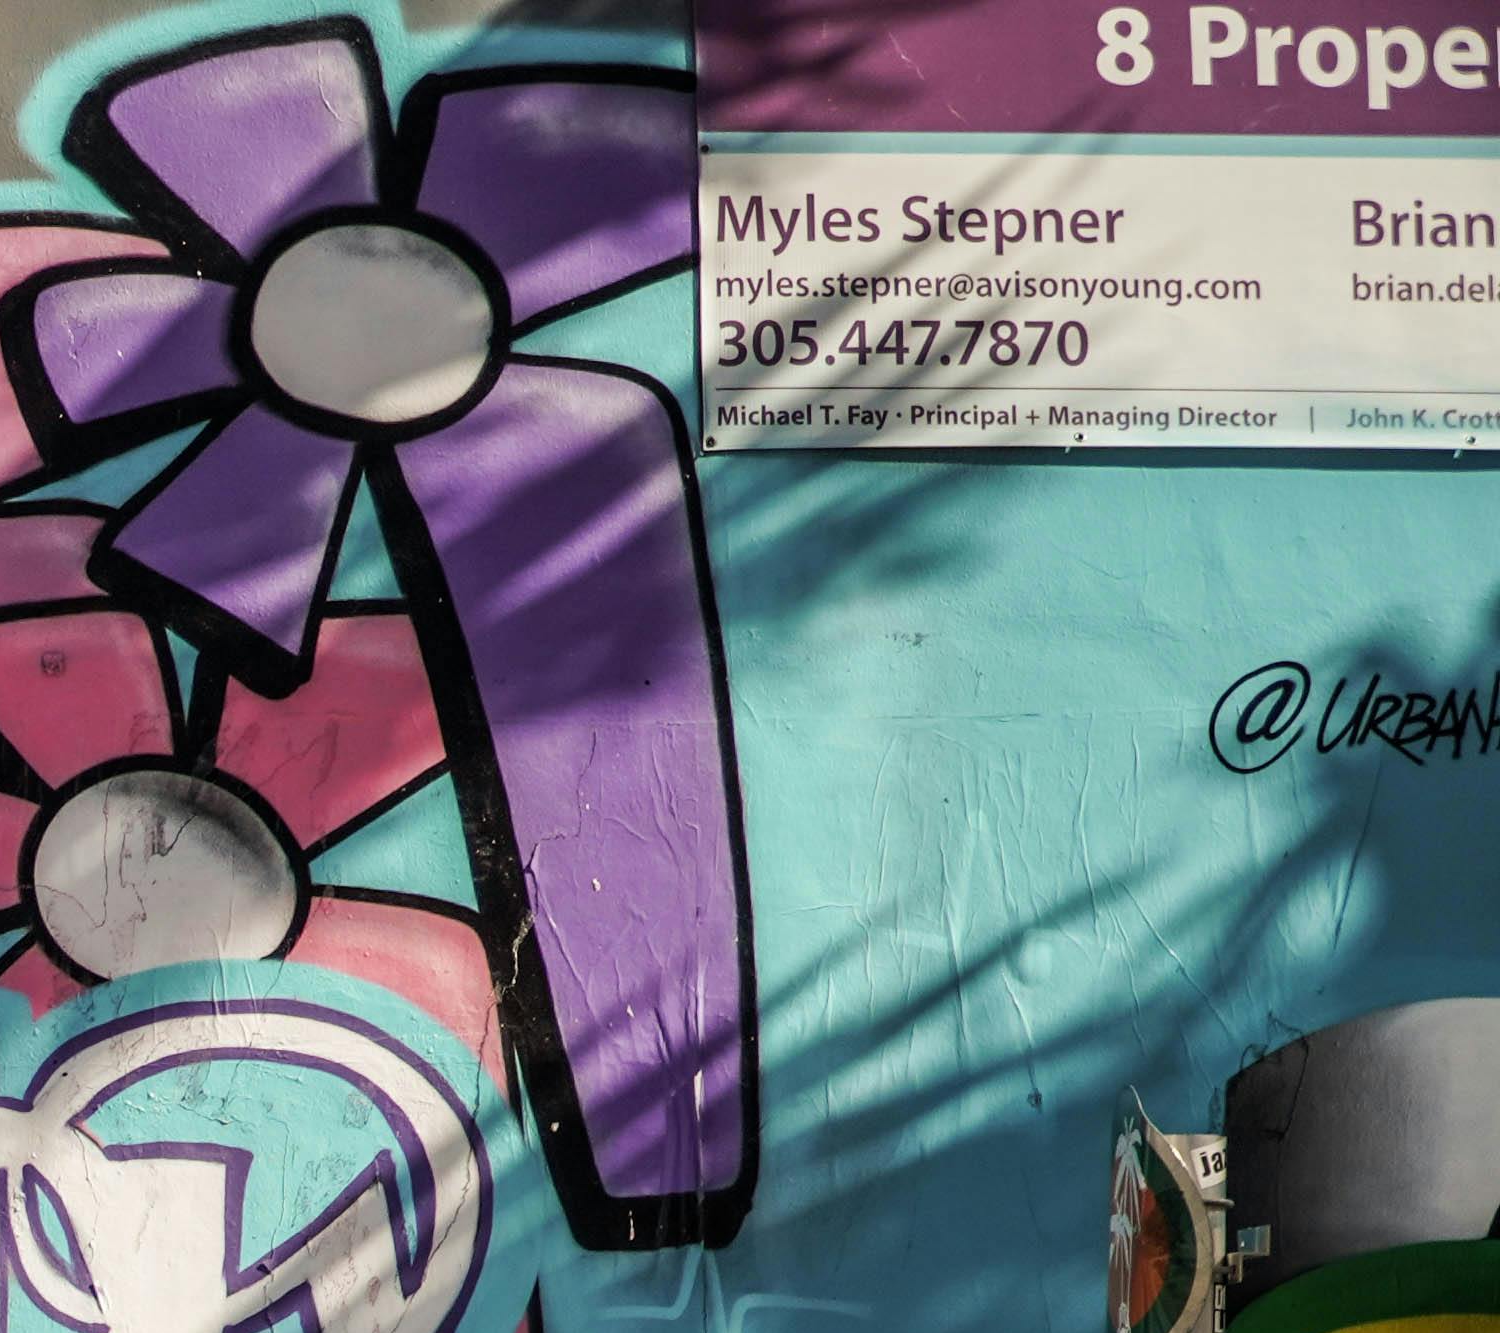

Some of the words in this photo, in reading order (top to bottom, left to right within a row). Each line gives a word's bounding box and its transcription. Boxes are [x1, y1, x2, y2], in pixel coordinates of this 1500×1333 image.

[1096, 7, 1155, 87] 8
[1190, 7, 1500, 110] Prope
[716, 194, 880, 255] Myles
[902, 195, 1125, 256] Stepner
[1352, 199, 1496, 248] Brian
[716, 269, 1262, 306] myles.stepner@avisonyoung.com
[717, 320, 1089, 366] 305.447.7870
[717, 405, 812, 427] Michael
[819, 406, 840, 426] T.
[847, 406, 889, 432] Fay
[910, 406, 1017, 431] Principal
[1048, 407, 1170, 430] Managing
[1179, 407, 1278, 428] Director
[1346, 408, 1403, 429] John
[1413, 408, 1436, 429] K.
[1199, 1150, 1227, 1178] ja
